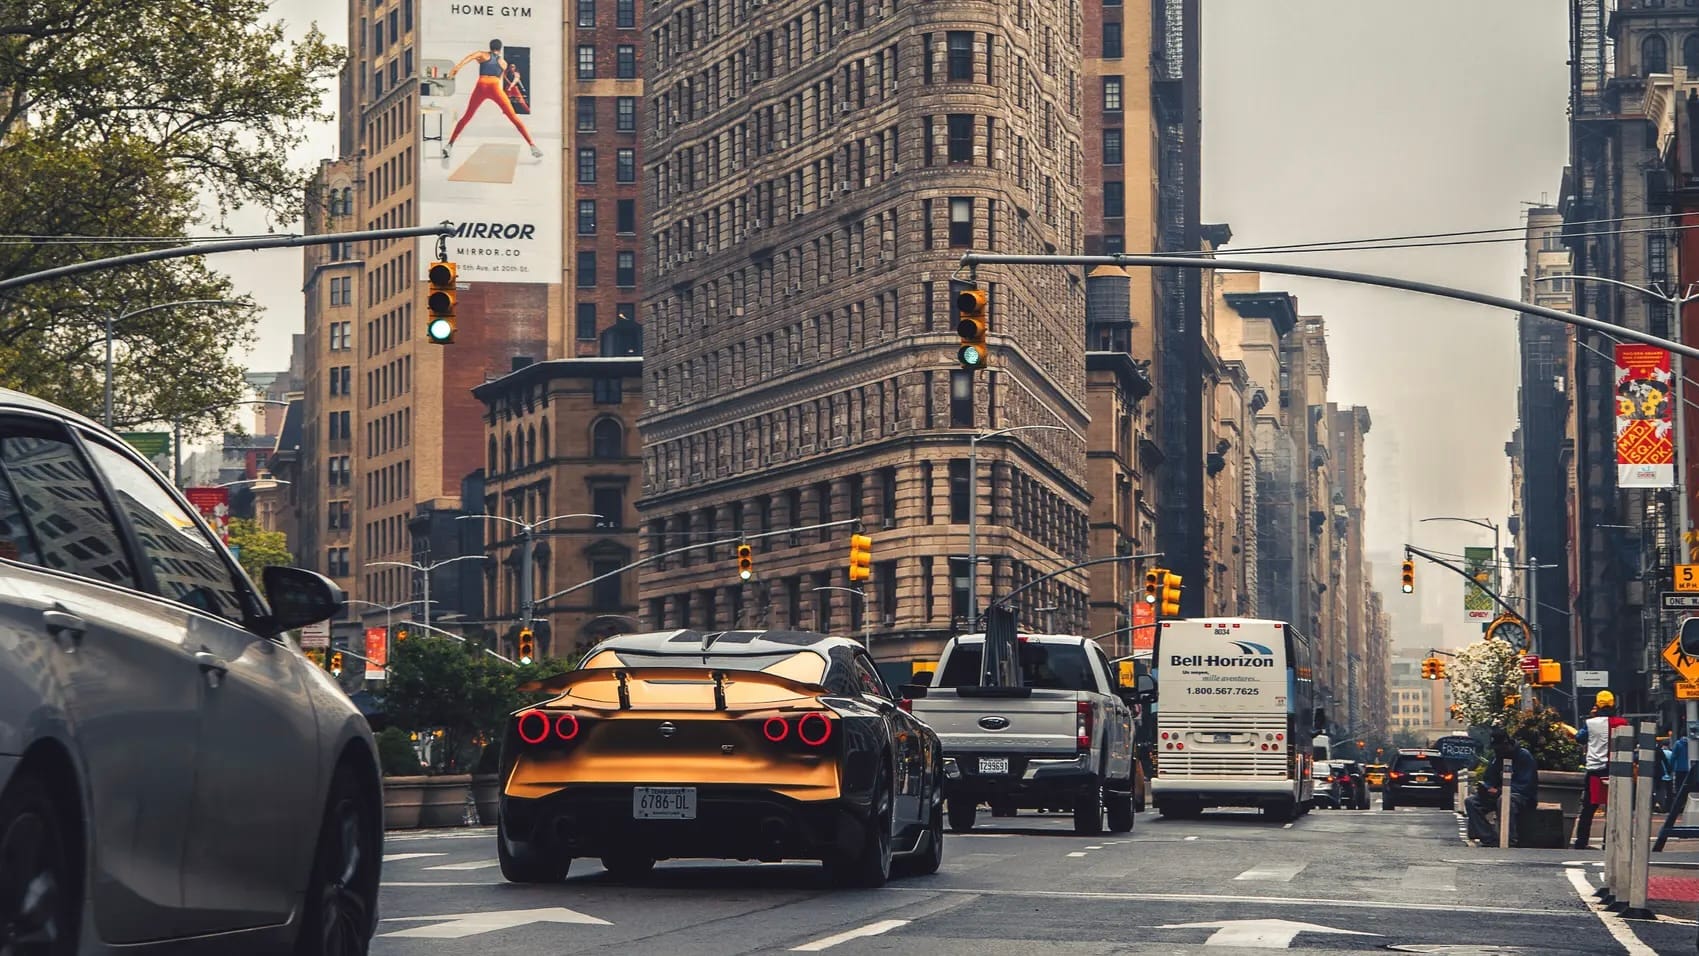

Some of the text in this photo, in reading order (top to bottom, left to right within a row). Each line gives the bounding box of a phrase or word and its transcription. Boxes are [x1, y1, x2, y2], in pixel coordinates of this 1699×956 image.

[451, 4, 532, 17] HOME GYM
[457, 248, 521, 257] MIRROR.CO
[1619, 426, 1649, 452] MAD.
[1631, 445, 1652, 462] SQ.
[1651, 447, 1671, 464] PK.
[1683, 568, 1693, 581] 5
[1171, 655, 1274, 667] Bell-Horizon
[1187, 687, 1259, 695] 1.800.567.7625
[1442, 743, 1475, 755] FROZEN
[641, 795, 689, 809] 6786-DL
